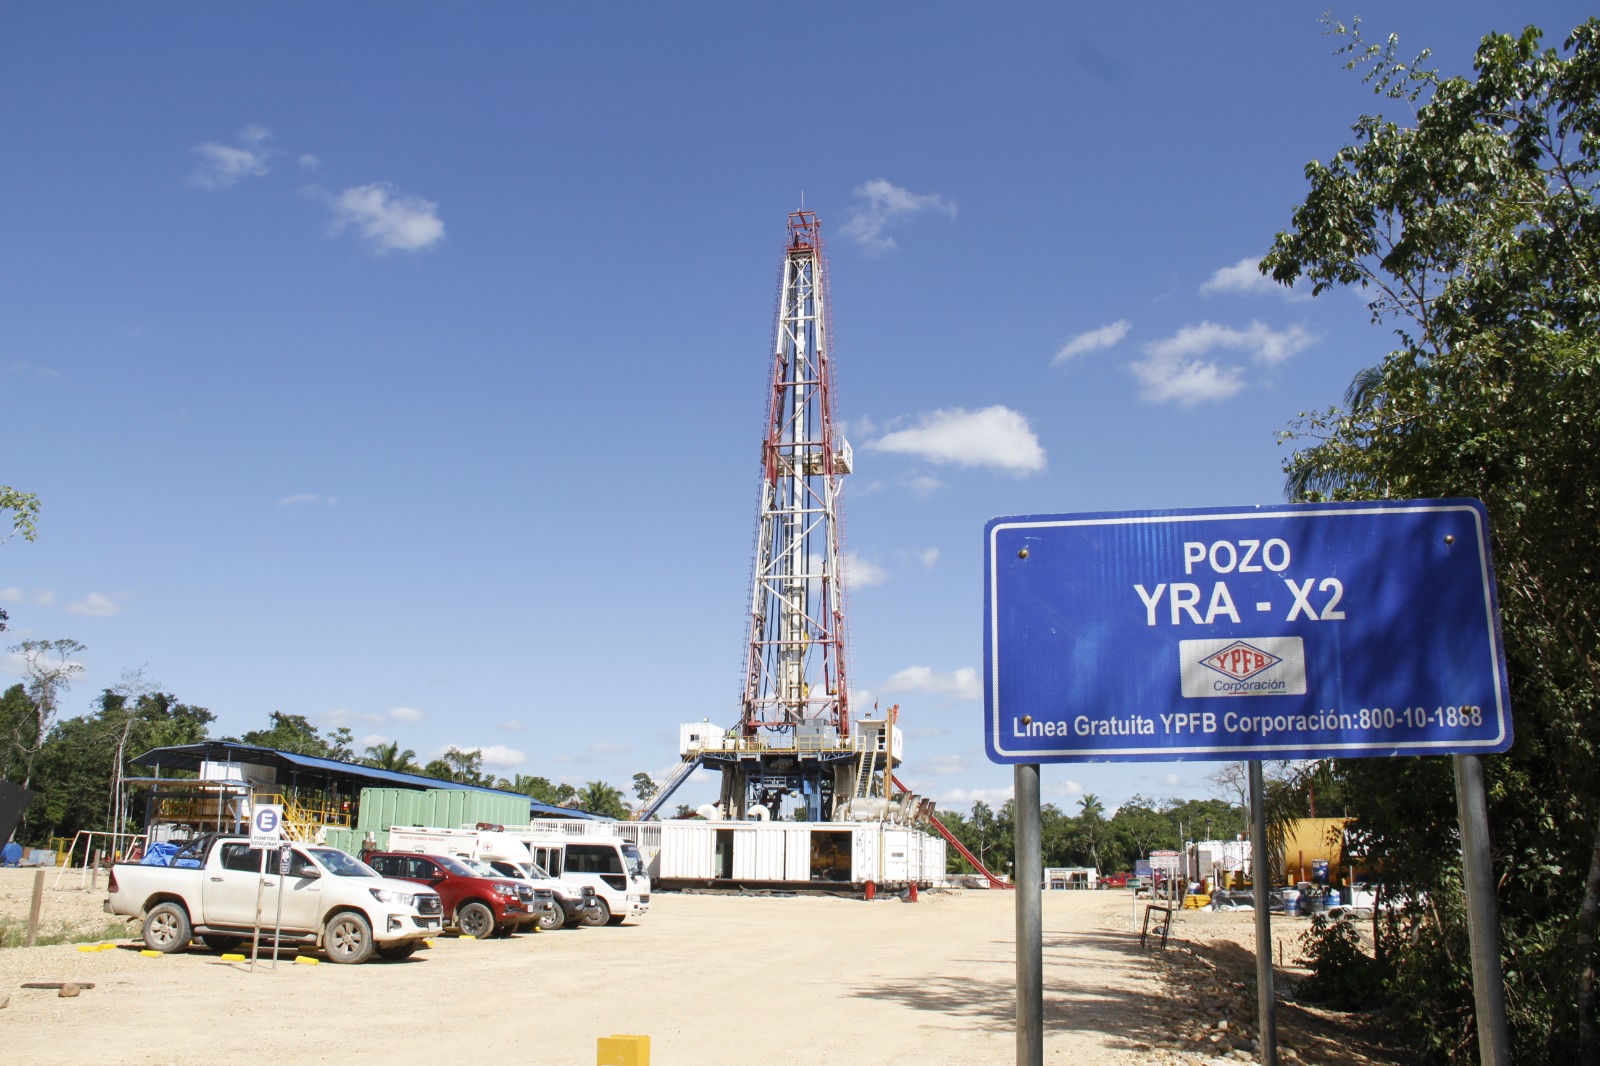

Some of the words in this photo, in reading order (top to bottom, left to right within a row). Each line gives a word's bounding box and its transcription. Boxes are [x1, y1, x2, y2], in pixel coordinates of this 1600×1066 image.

[1184, 538, 1291, 574] POZO
[1133, 581, 1241, 626] YRA
[1256, 602, 1271, 612] -
[1284, 577, 1346, 622] X2
[1215, 648, 1265, 674] YPFB
[1213, 679, 1286, 693] Corporación
[1074, 714, 1155, 736] Gratuita
[1160, 711, 1217, 734] YPFB
[260, 813, 273, 829] E
